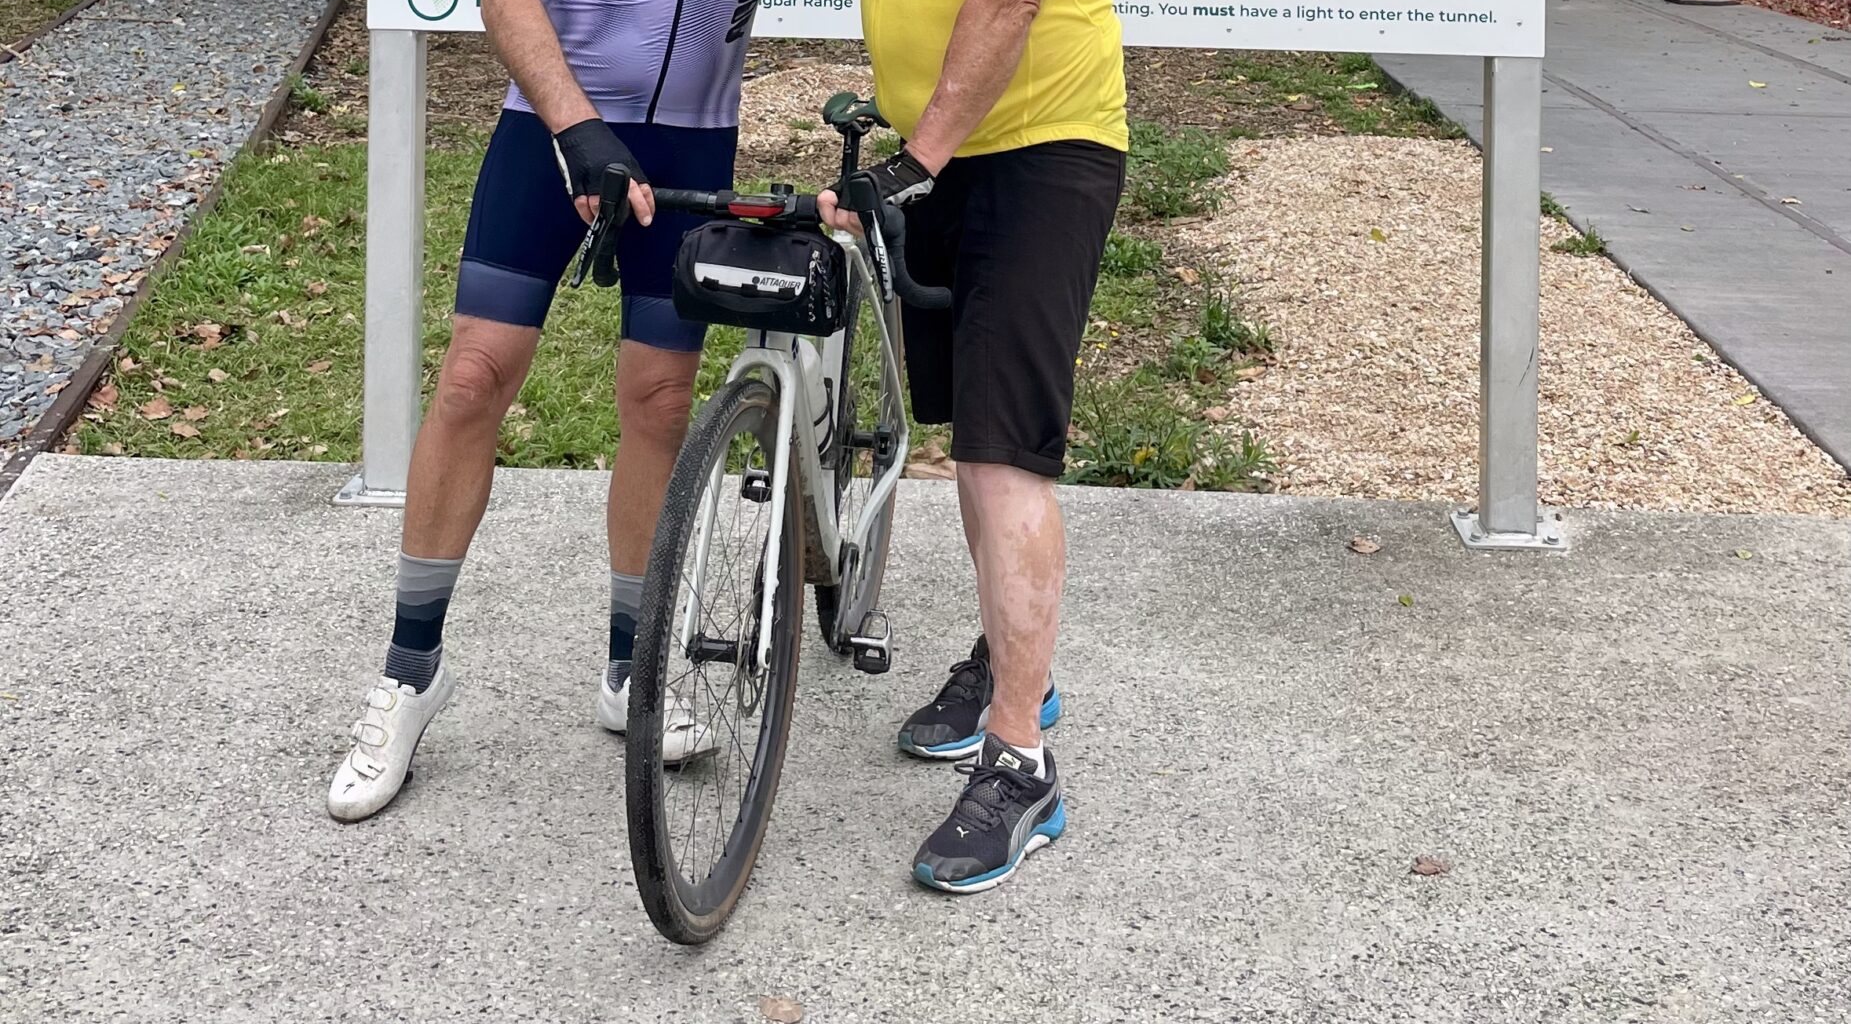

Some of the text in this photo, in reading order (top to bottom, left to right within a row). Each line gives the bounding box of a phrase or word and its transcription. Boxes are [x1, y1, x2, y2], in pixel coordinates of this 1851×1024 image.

[1158, 2, 1497, 24] You must have a light to enter the tunnel.
[760, 277, 801, 289] ATTAQUER
